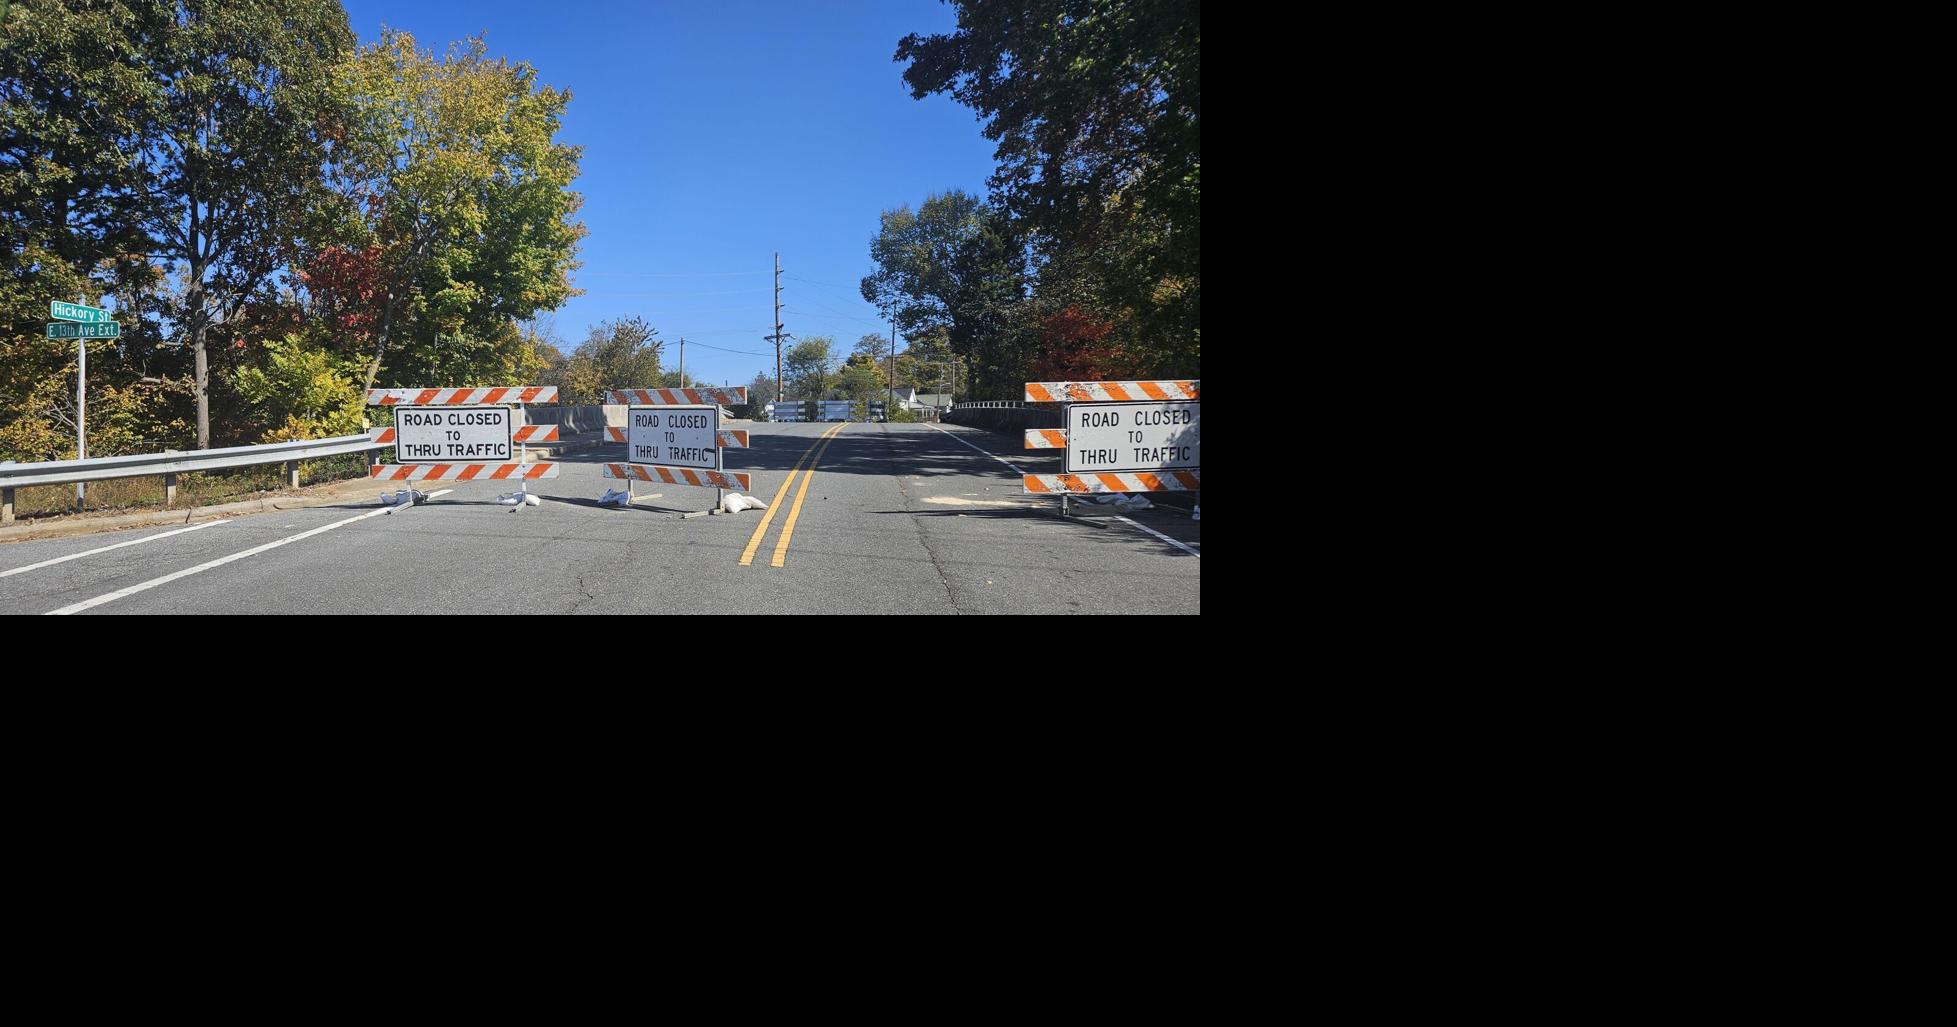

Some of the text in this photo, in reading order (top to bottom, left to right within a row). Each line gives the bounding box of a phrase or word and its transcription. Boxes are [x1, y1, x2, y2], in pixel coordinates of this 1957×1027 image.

[54, 303, 95, 322] Hickory
[49, 324, 117, 337] E. 13th Ave Ext.
[404, 413, 502, 426] ROAD CLOSED
[635, 415, 707, 429] ROAD CLOSED
[1081, 409, 1191, 427] ROAD CLOSED
[445, 430, 461, 441] TO
[664, 432, 675, 443] TO
[1128, 430, 1143, 443] TO
[405, 443, 506, 456] THRU TRAFFIC
[635, 445, 708, 462] THRU TRAFFIC
[1080, 446, 1191, 464] THRU TRAFFIC
